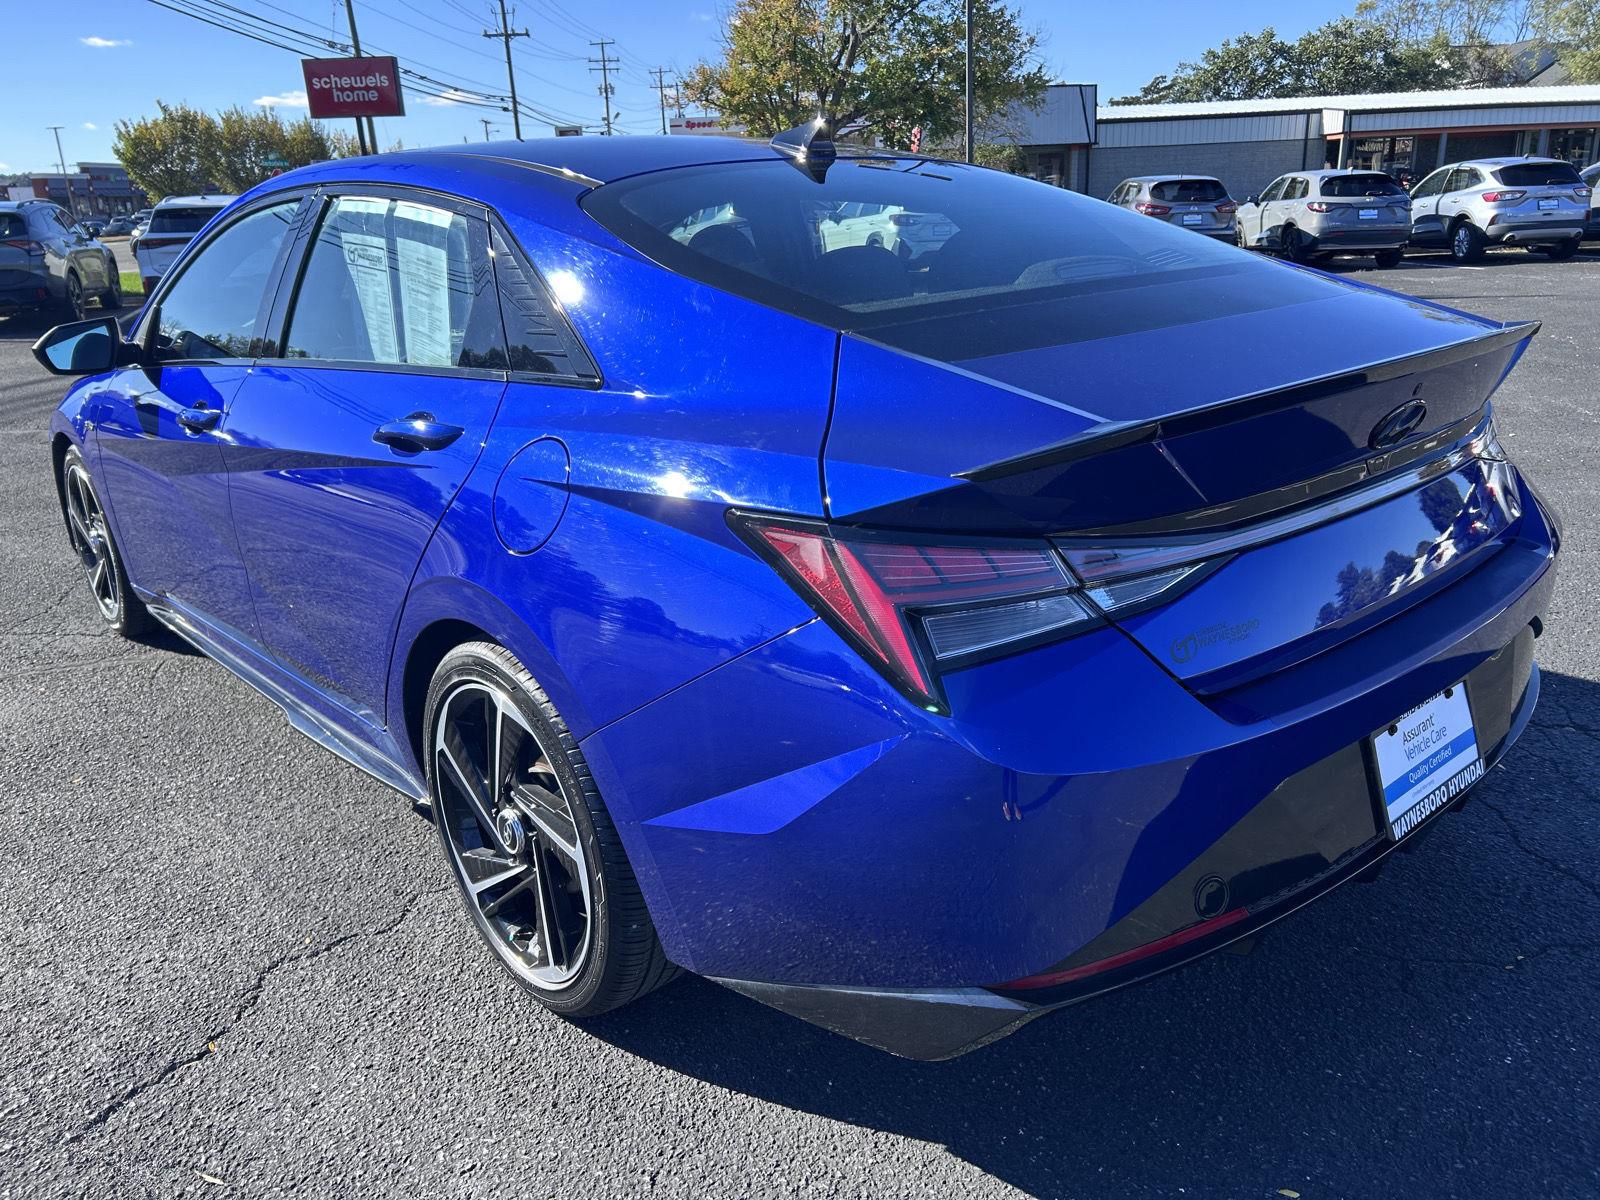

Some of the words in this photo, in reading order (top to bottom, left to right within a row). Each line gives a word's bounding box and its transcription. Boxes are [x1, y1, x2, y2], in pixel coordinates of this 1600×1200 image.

[312, 73, 389, 89] schewels
[333, 88, 379, 102] home
[685, 119, 716, 130] Speed
[1403, 714, 1434, 745] Assurant
[1404, 736, 1431, 761] Vehicle
[1430, 726, 1447, 747] Care
[1408, 763, 1429, 783] Quality
[1429, 747, 1452, 769] Certified
[1392, 786, 1447, 841] WAYNESBORO
[1449, 758, 1485, 797] HYUNDAI
